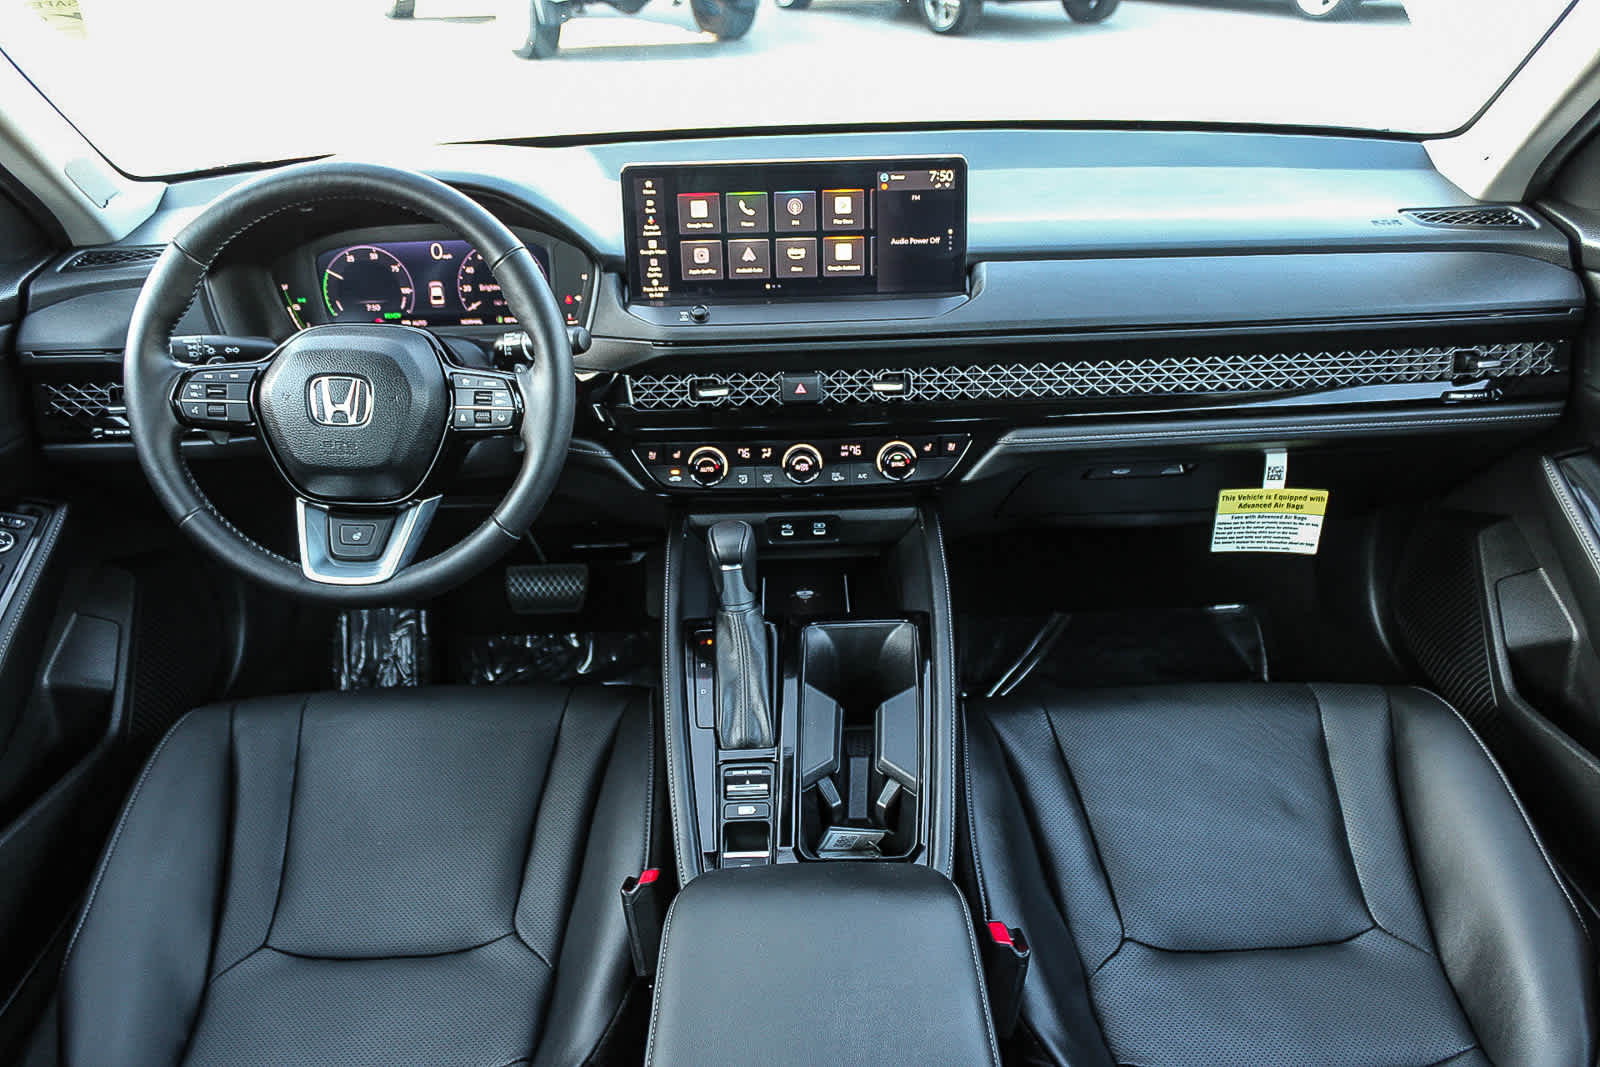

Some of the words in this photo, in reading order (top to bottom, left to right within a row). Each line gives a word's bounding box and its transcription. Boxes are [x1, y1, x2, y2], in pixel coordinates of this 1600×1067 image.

[929, 170, 954, 182] 7:50
[909, 237, 929, 245] Power
[929, 236, 941, 245] Off
[430, 243, 443, 260] 0
[1273, 494, 1308, 502] Equipped
[1309, 495, 1326, 503] with
